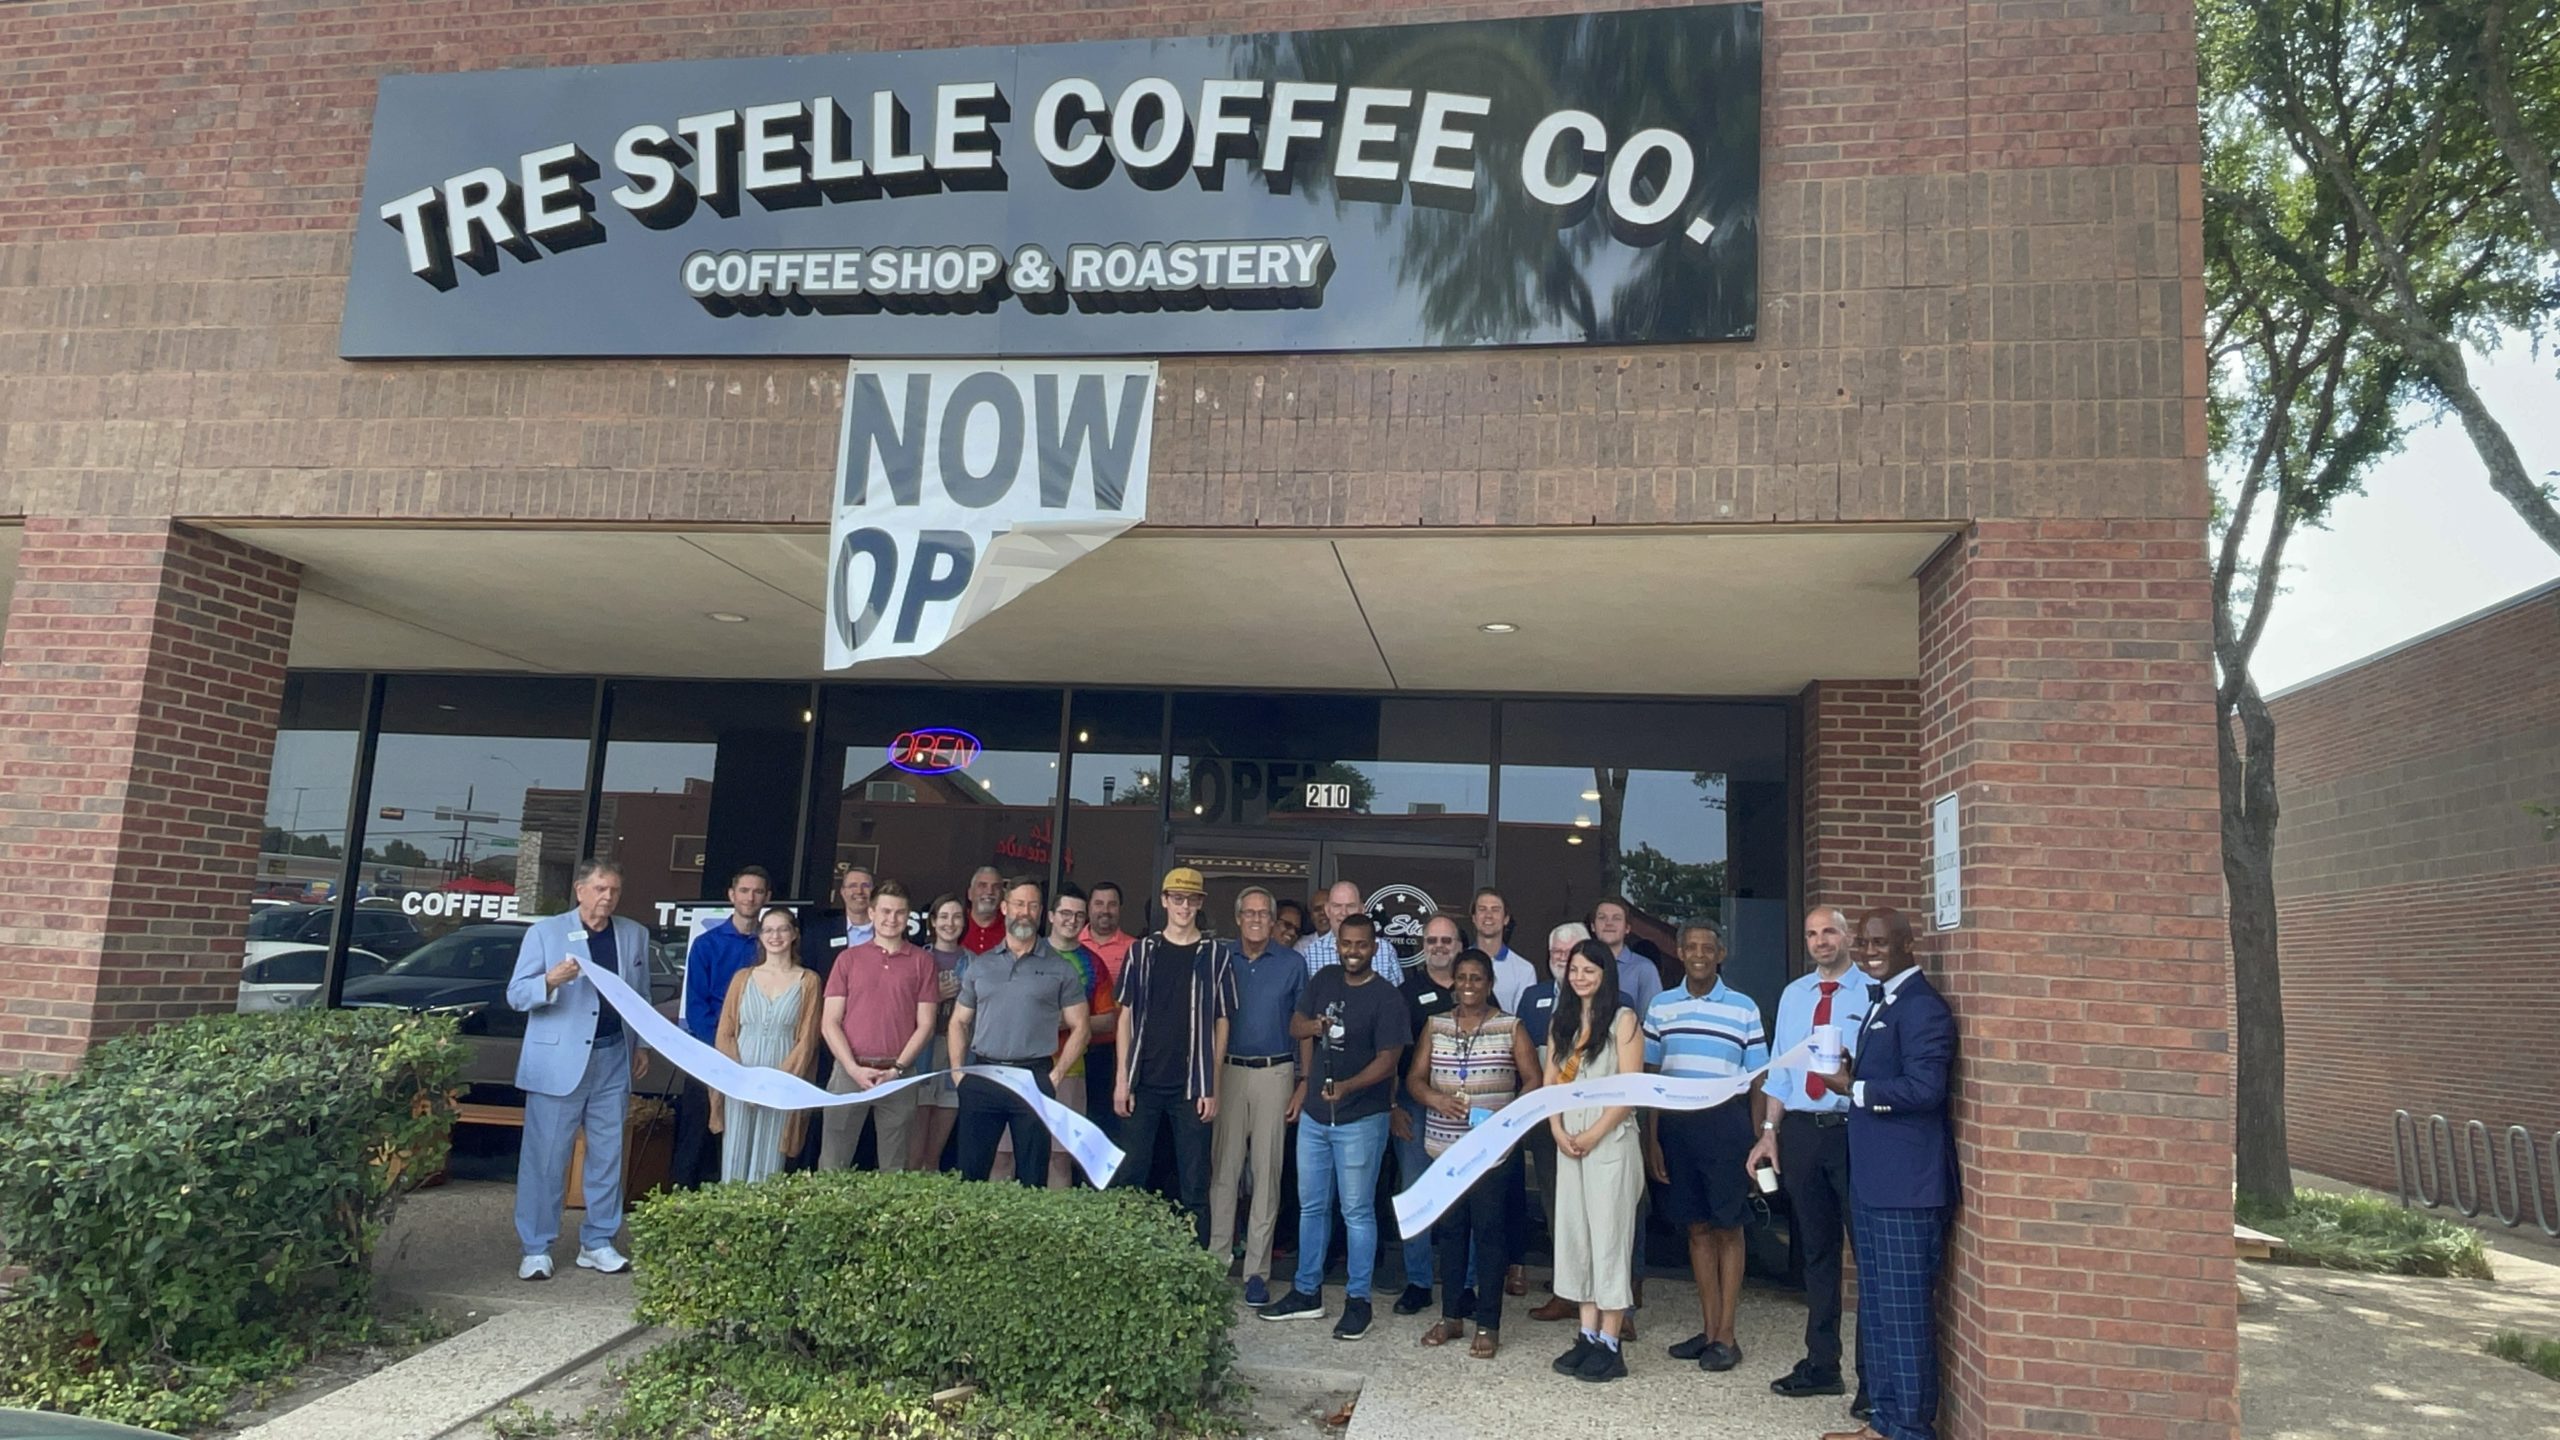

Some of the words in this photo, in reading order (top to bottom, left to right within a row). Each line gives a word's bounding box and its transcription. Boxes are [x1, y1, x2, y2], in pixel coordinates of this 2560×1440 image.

[380, 142, 582, 275] TRE
[611, 81, 997, 212] STELLE
[1032, 77, 1491, 190] COFFEE
[1520, 109, 1715, 244] CO.
[684, 248, 861, 294] COFFEE
[867, 246, 998, 292] SHOP
[1012, 245, 1051, 291] &
[1070, 240, 1325, 290] ROASTERY
[844, 371, 1151, 511] NOW
[833, 526, 1005, 651] OP
[891, 732, 976, 769] OPEN
[1190, 757, 1322, 824] OPE
[1308, 784, 1348, 807] 210
[402, 891, 520, 920] COFFEE
